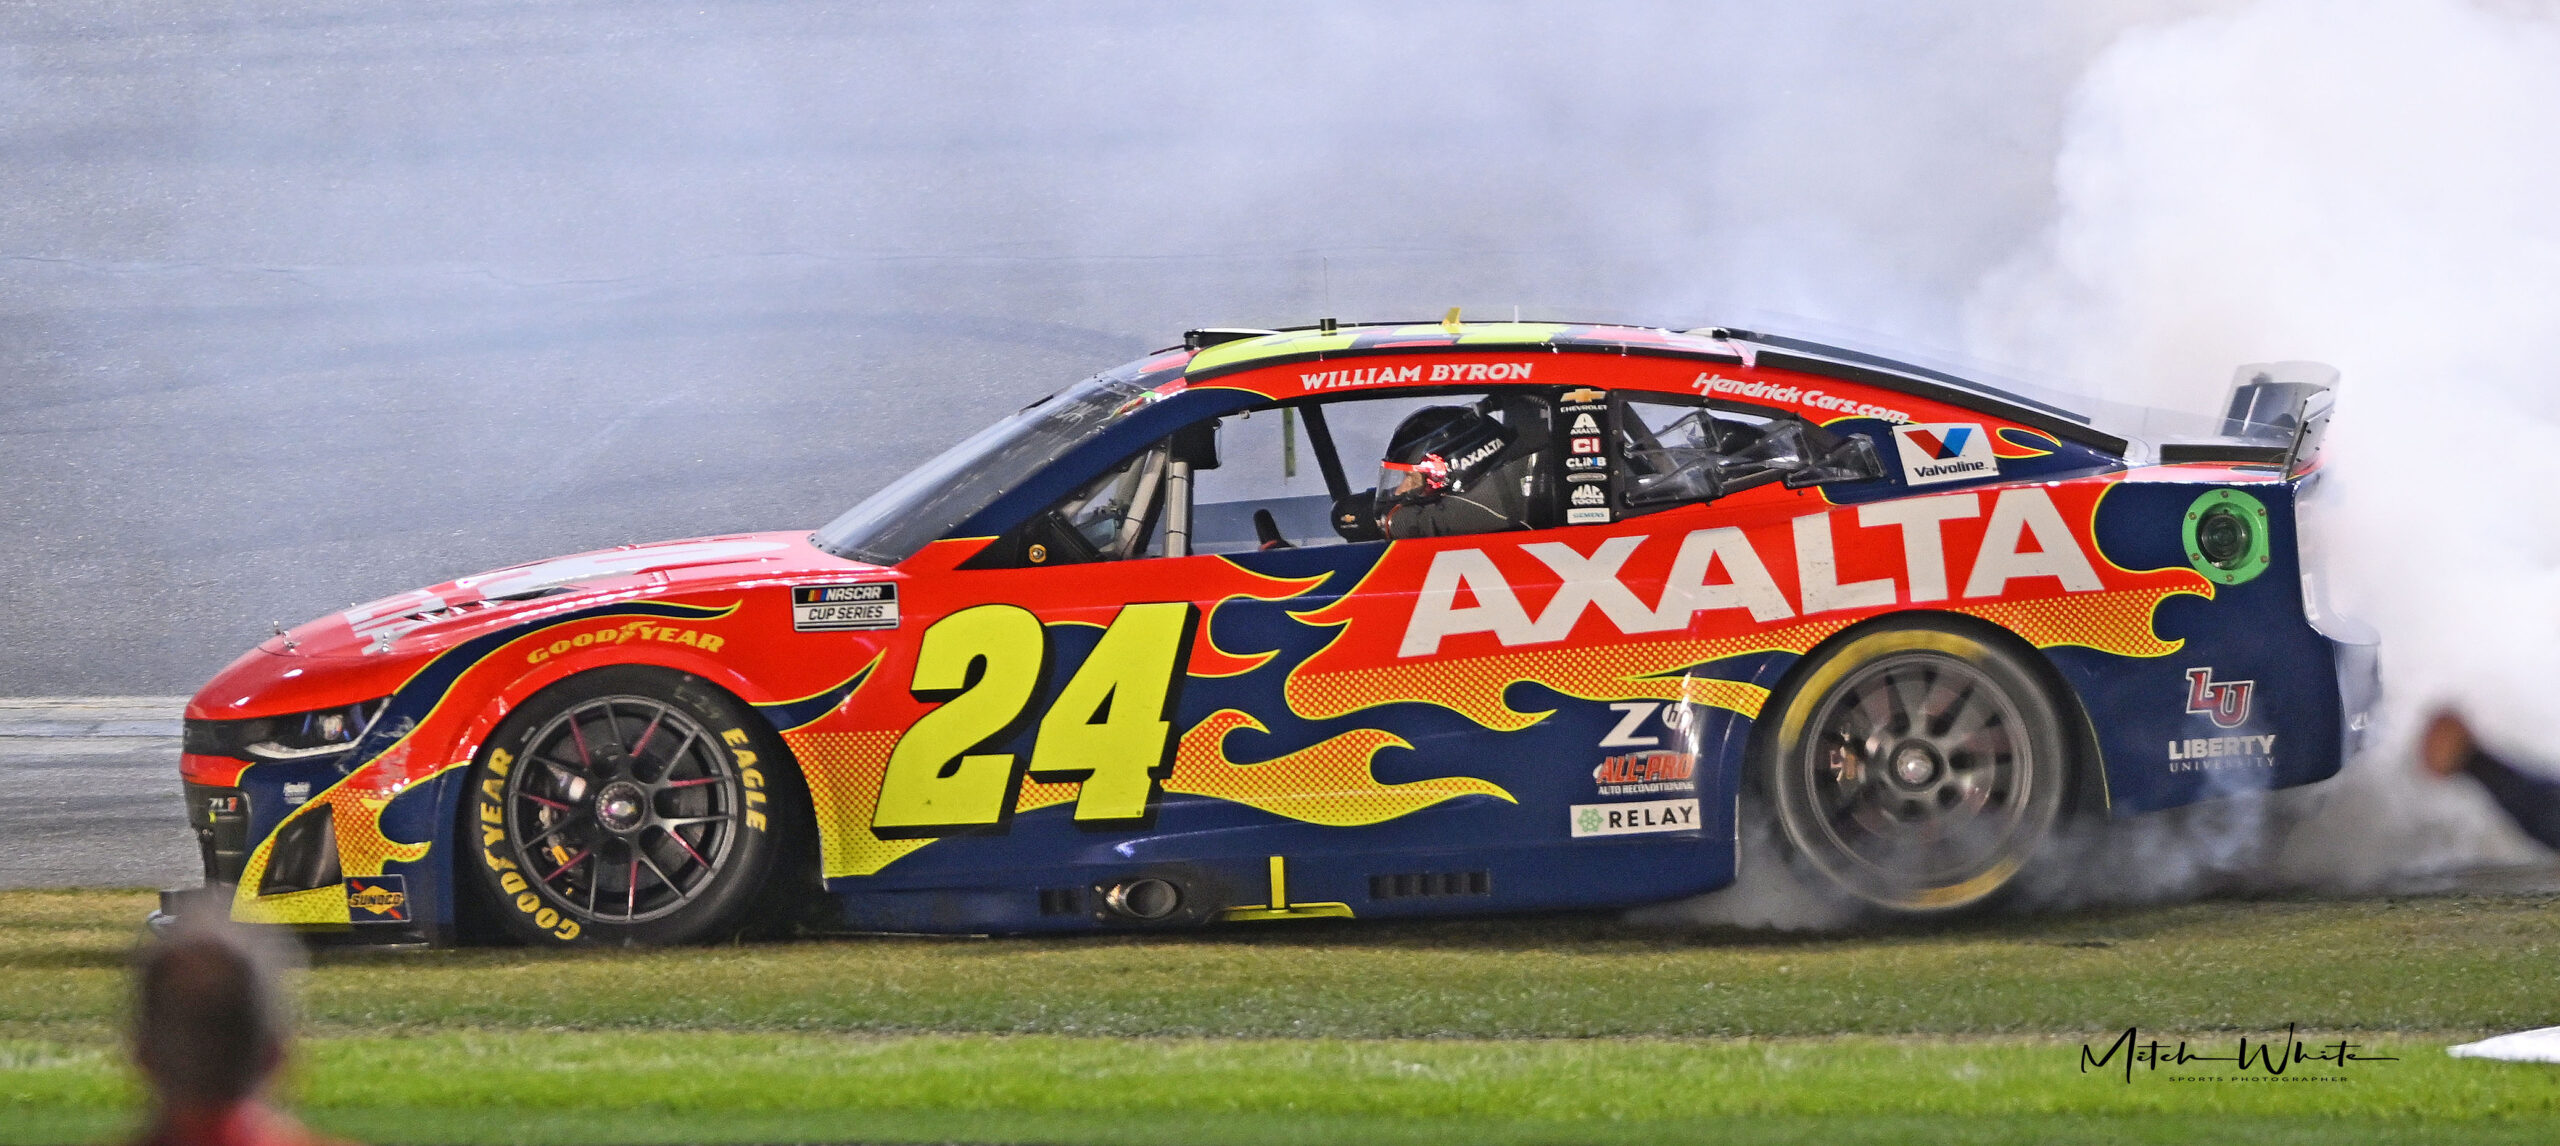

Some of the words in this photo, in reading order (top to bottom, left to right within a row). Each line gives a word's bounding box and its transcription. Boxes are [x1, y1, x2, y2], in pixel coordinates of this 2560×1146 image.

[1300, 365, 1422, 391] WILLIAM
[1429, 363, 1533, 381] BYRON
[1560, 404, 1607, 413] CHEVROLET
[1461, 438, 1505, 471] AXALTA
[1398, 487, 2105, 659] AXALTA
[826, 586, 882, 602] NASCAR
[808, 607, 836, 620] CUP
[837, 605, 884, 620] SERIES
[527, 620, 726, 665] GOODYEAR
[2185, 667, 2254, 729] LU
[870, 602, 1202, 841] 24
[1598, 702, 1661, 747] Z
[2168, 734, 2277, 761] LIBERTY
[1596, 753, 1696, 784] ALL-PRO
[2169, 756, 2276, 773] UNIVERSITY
[721, 727, 768, 833] EAGLE
[1598, 786, 1622, 795] AUTO
[1608, 806, 1693, 829] RELAY
[480, 746, 581, 941] GOODYEAR
[352, 893, 402, 907] SUNOCO
